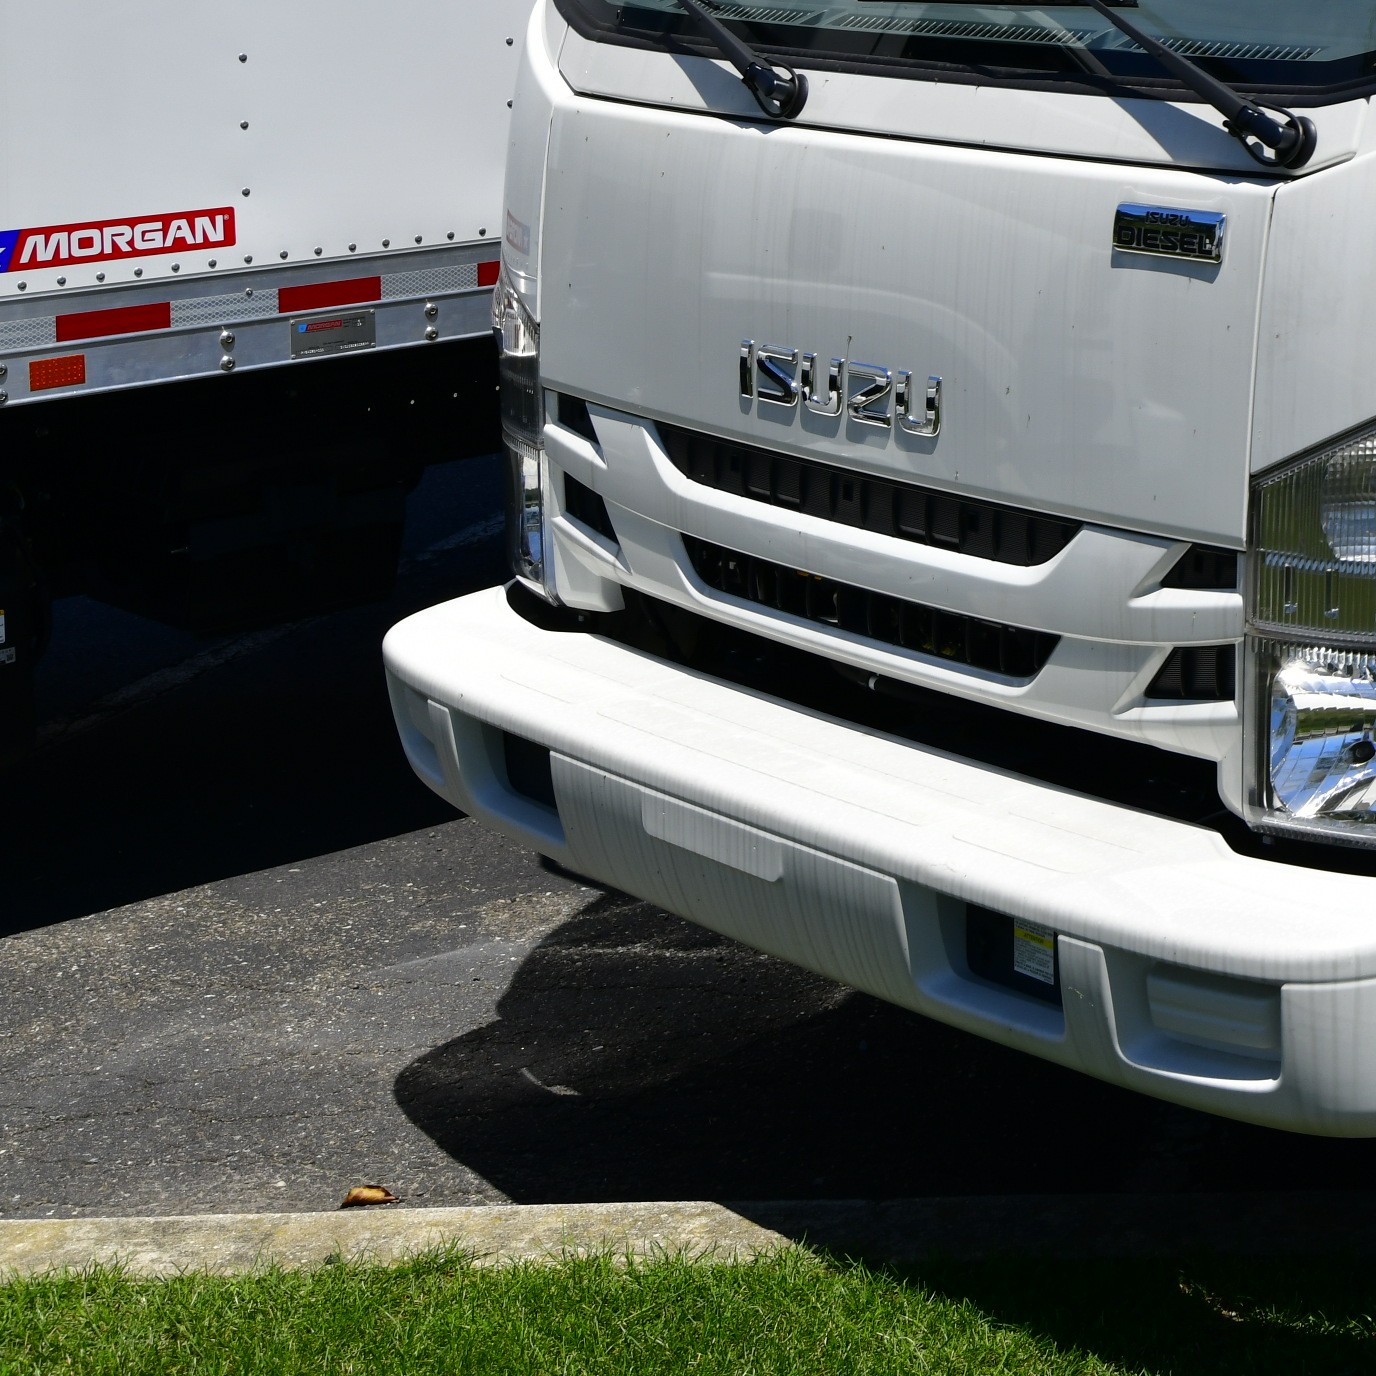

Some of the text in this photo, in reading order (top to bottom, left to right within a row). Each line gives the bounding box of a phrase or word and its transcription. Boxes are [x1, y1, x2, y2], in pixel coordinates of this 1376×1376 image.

[19, 214, 225, 264] MORGAN
[1145, 211, 1189, 228] ISUZU
[1117, 226, 1215, 257] DIESEL
[739, 339, 943, 437] ISUZU
